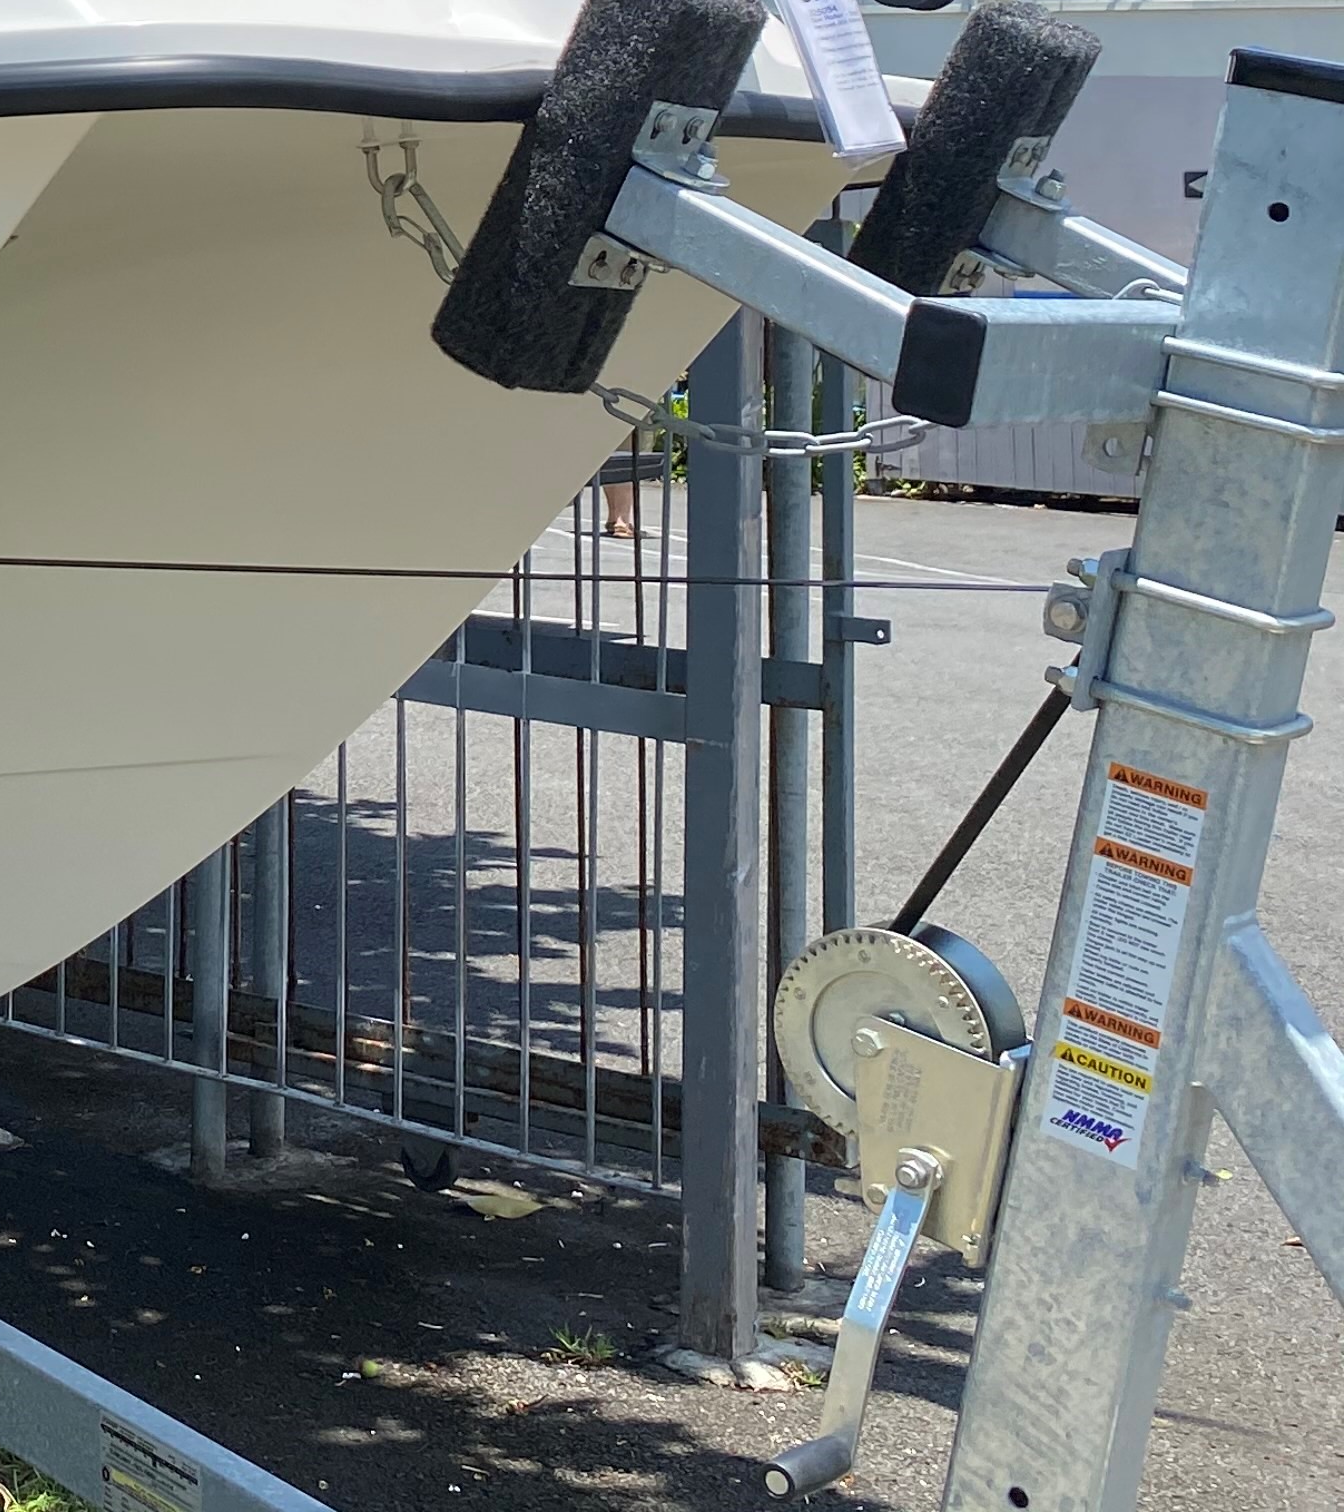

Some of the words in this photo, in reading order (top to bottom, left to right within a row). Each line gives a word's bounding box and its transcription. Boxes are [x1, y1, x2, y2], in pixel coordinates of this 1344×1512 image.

[1130, 771, 1202, 805] WARNING
[1115, 847, 1187, 881] WARNING
[1084, 1008, 1154, 1044] WARNING
[1077, 1054, 1147, 1089] CAUTION
[1050, 1117, 1105, 1142] CERTIFIED
[1062, 1109, 1123, 1140] NMMA
